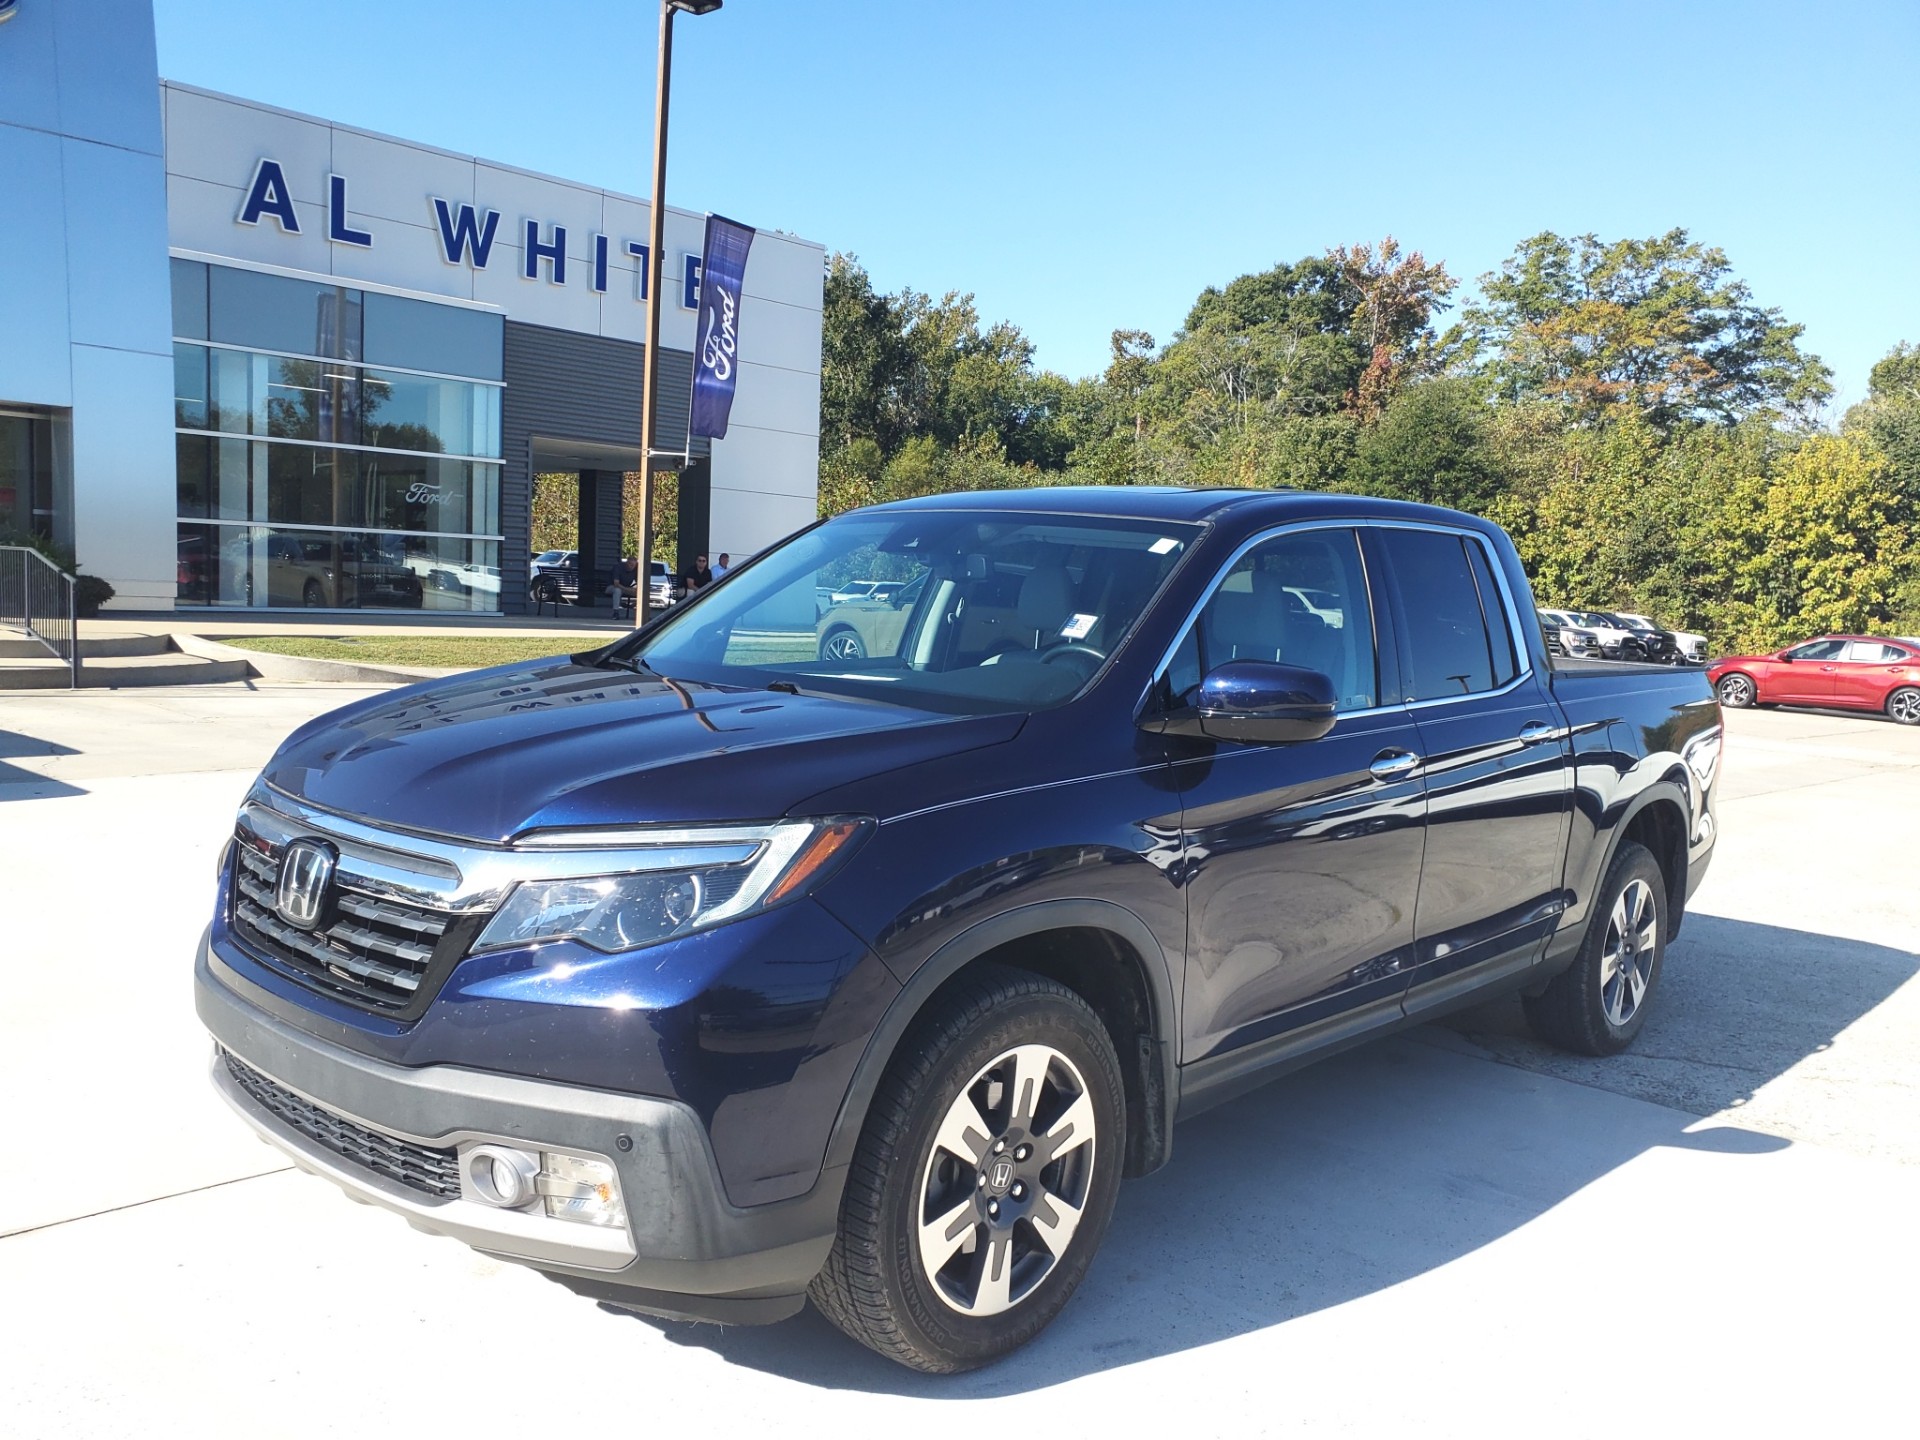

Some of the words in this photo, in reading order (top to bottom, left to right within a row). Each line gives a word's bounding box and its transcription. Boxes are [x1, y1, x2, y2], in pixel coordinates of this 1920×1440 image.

[237, 158, 374, 249] AL
[702, 285, 736, 381] Ford
[405, 482, 454, 506] Ford
[1086, 1033, 1120, 1116] DESTINATION
[899, 1257, 946, 1344] DESTINATION
